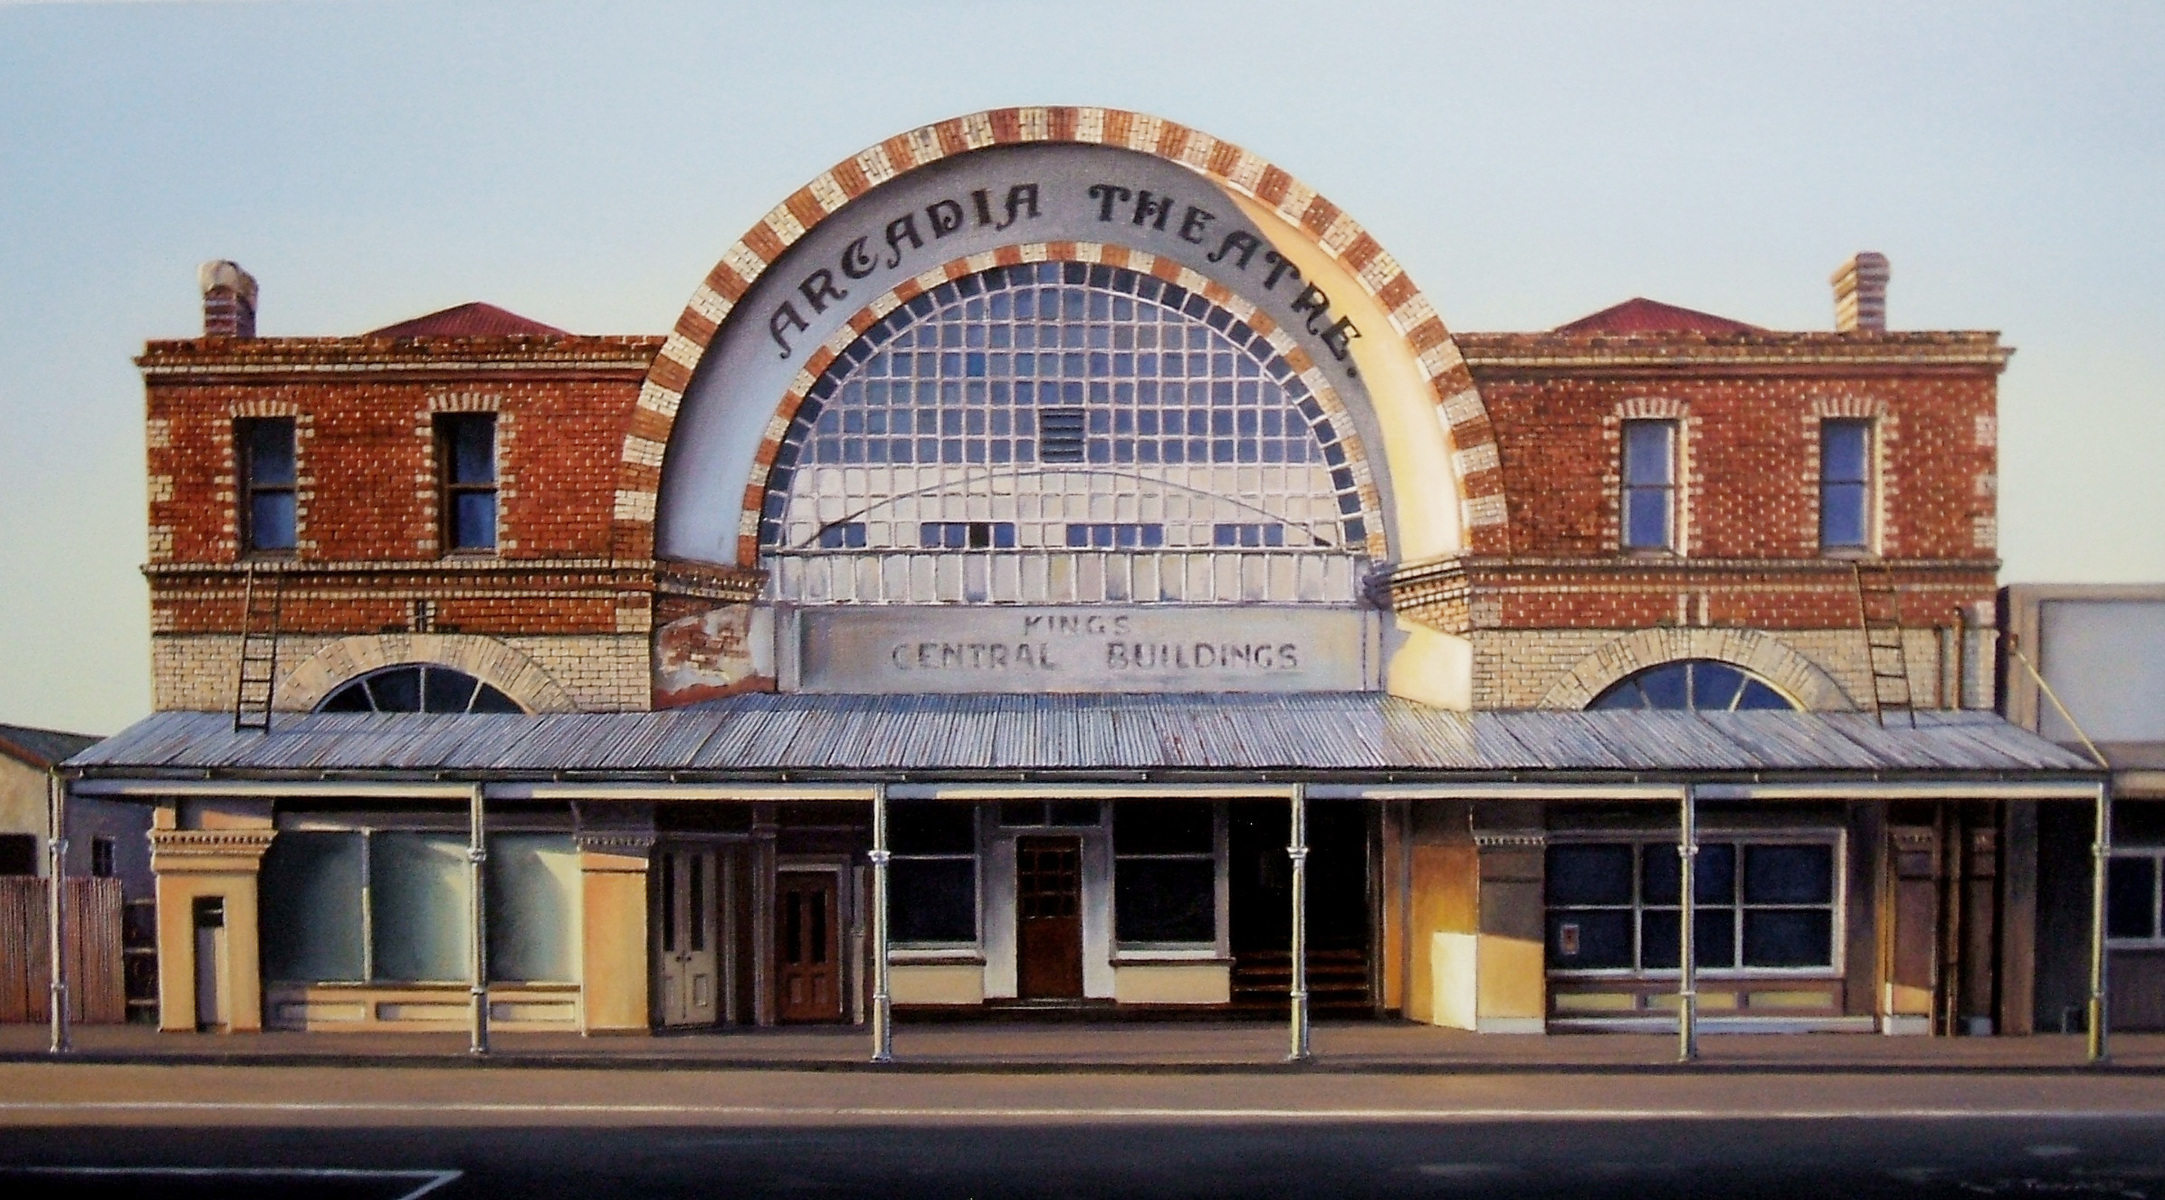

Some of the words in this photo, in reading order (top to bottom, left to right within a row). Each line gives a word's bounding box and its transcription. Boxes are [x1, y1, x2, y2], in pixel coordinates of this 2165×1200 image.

[767, 182, 1041, 359] ARCADIA
[1024, 614, 1131, 635] KINGS
[892, 643, 1056, 671] CENTRAL
[1107, 641, 1301, 670] BUILDINGS
